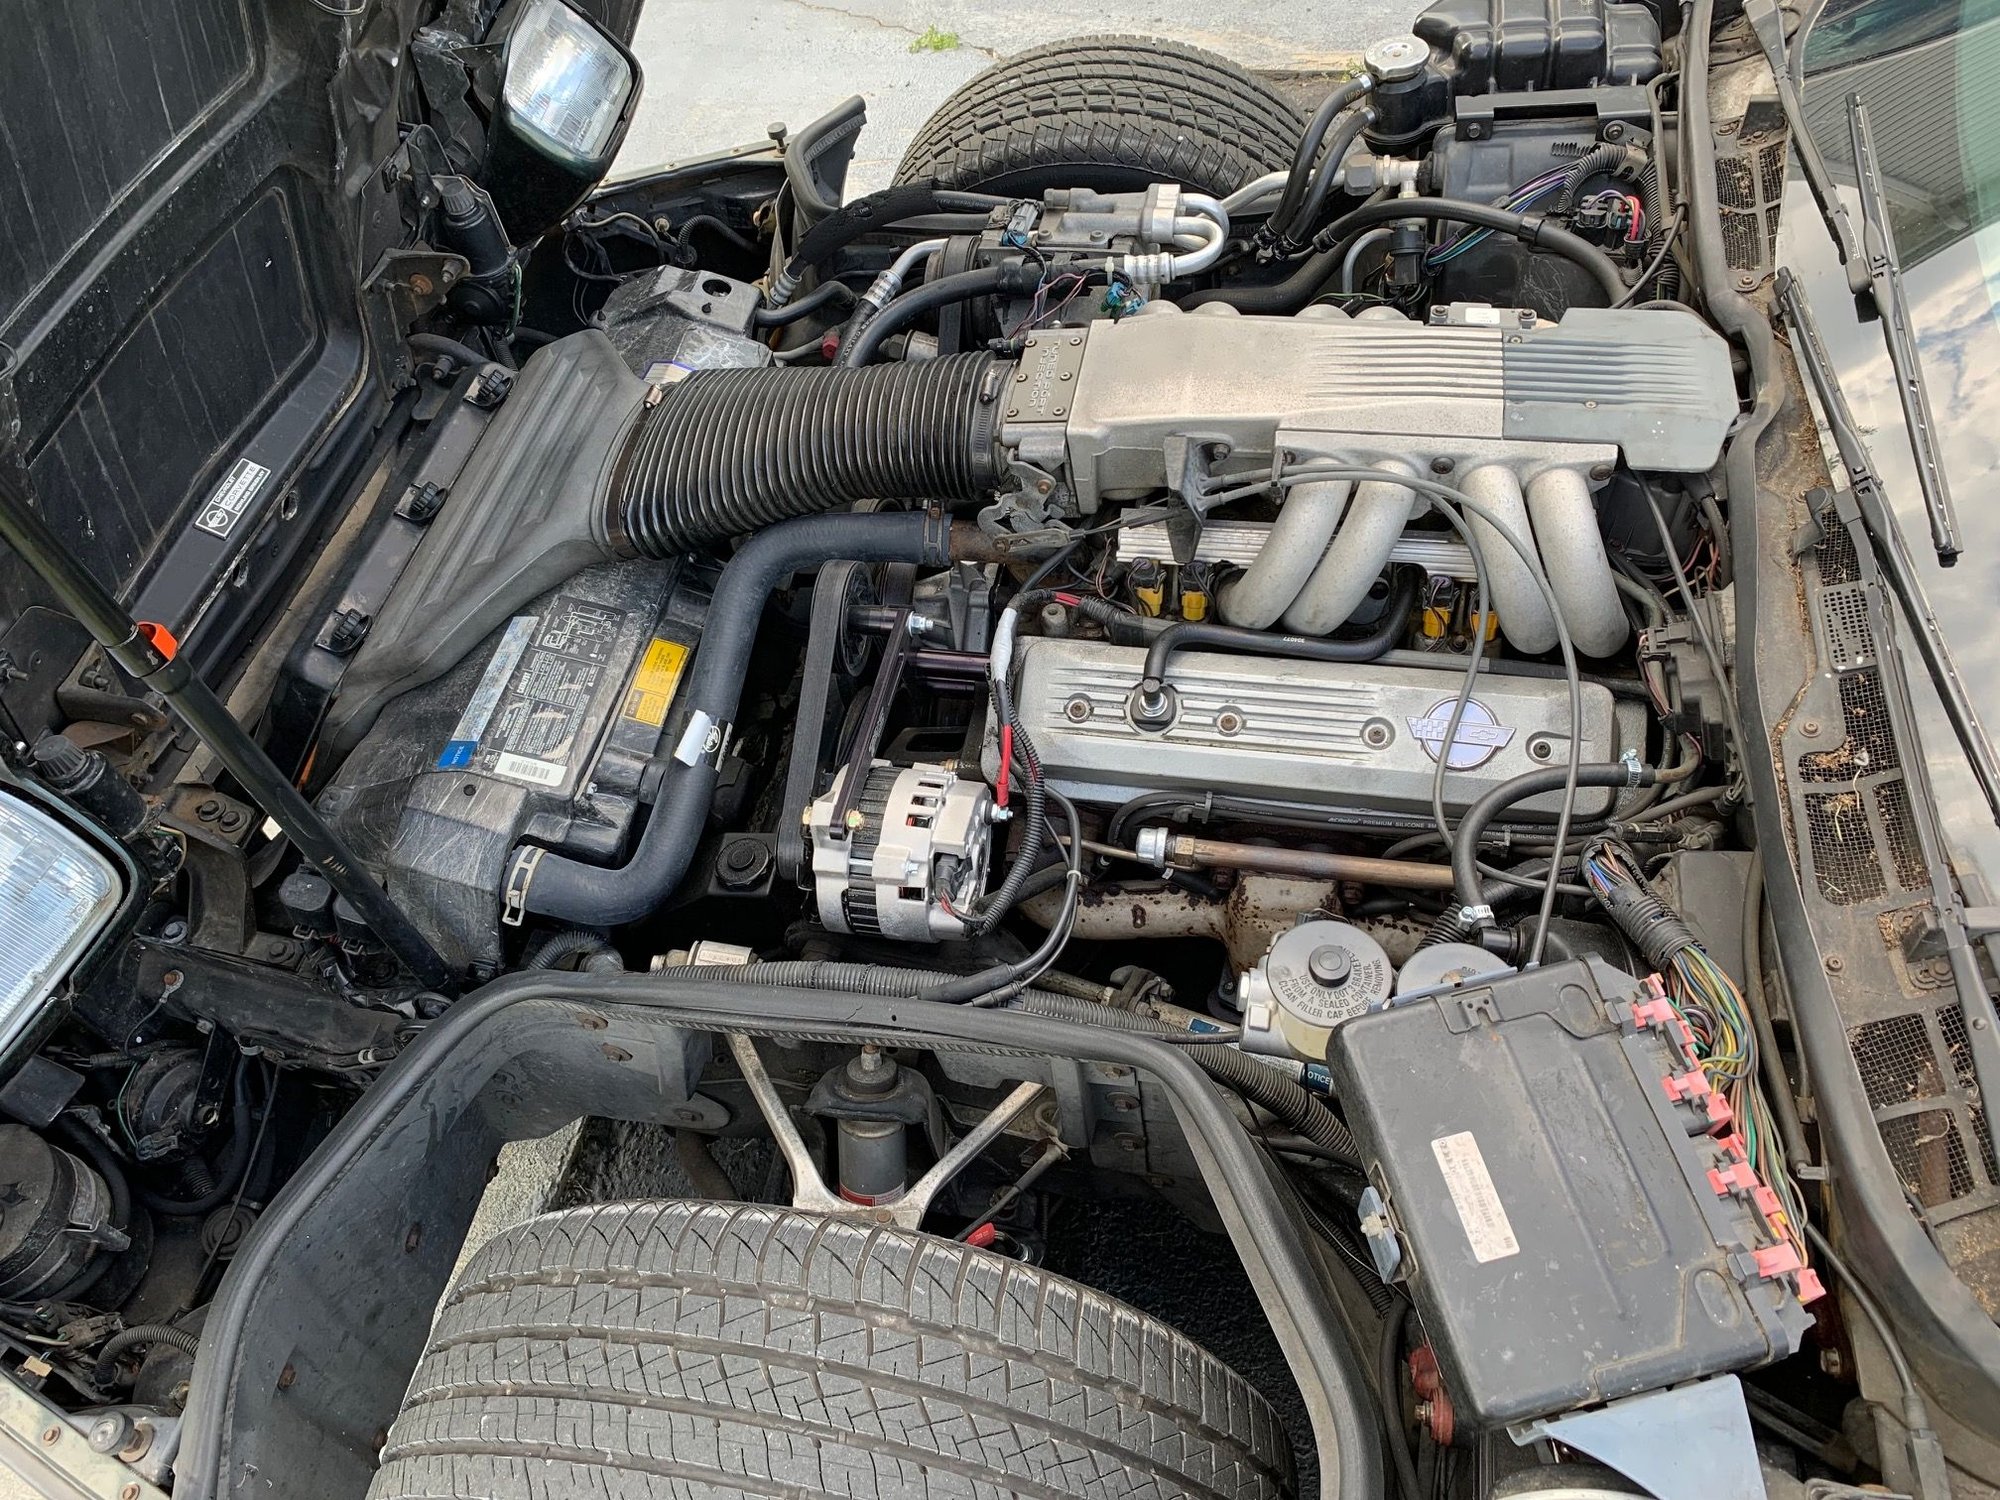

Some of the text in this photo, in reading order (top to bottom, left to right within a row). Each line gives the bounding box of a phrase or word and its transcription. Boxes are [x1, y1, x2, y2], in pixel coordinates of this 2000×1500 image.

[1028, 346, 1049, 407] INJECTION
[1037, 339, 1061, 416] TUNED PORT
[225, 466, 256, 507] CORVETTE
[453, 745, 464, 765] NOTICE
[1279, 959, 1384, 1020] CLEAN FILLER CAP BEFORE REMOVING
[1287, 978, 1307, 999] FROM
[1309, 996, 1315, 1005] A
[1318, 998, 1351, 1009] SEALED
[1299, 974, 1313, 990] USE
[1310, 986, 1332, 1000] ONLY
[1334, 987, 1348, 1000] DOT
[1347, 984, 1356, 993] 3
[1352, 961, 1362, 987] BRAKE
